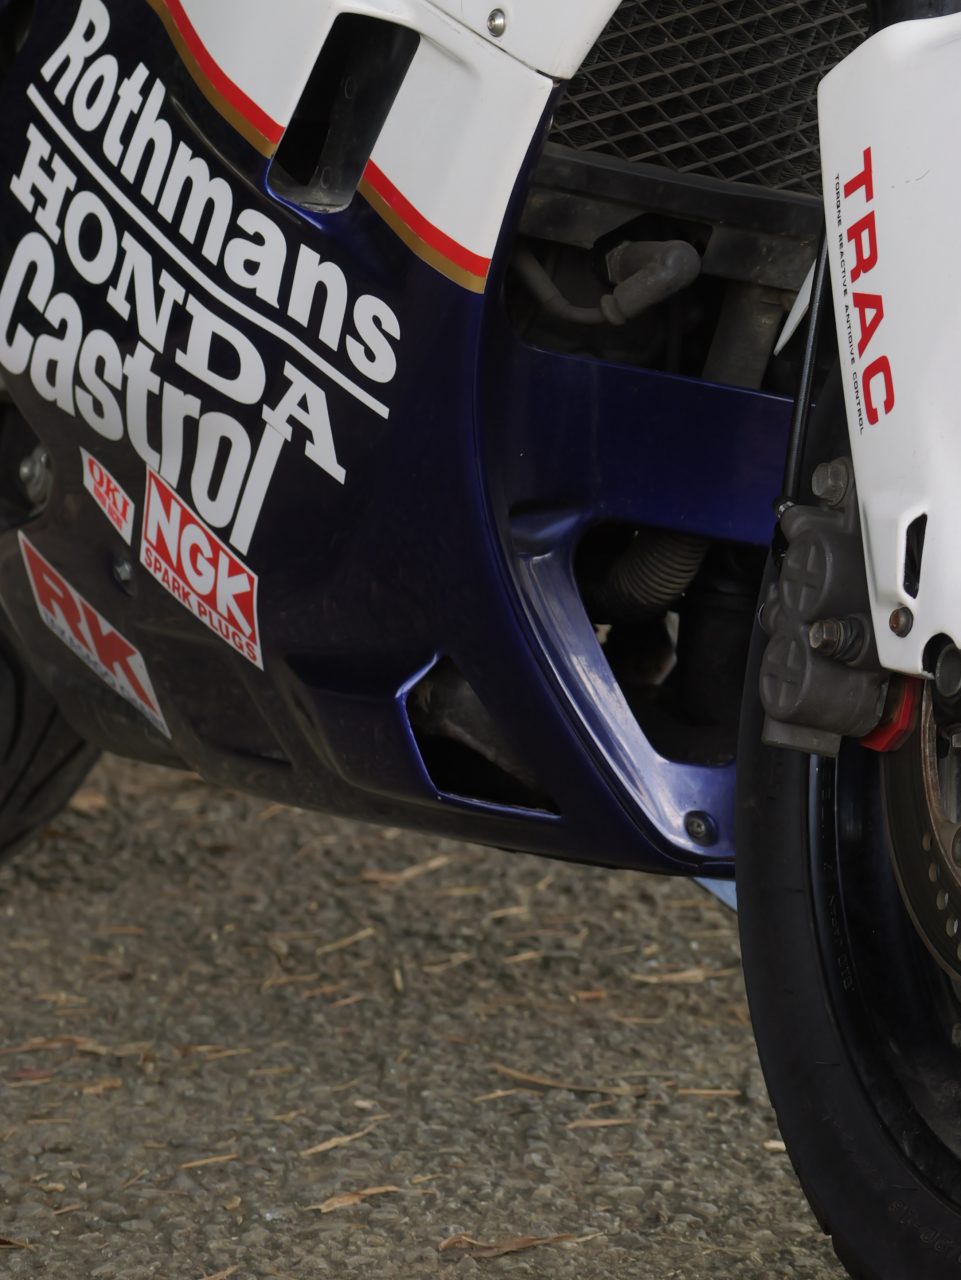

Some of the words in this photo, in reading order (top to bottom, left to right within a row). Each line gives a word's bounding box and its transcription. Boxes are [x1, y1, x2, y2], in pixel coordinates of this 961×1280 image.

[10, 123, 346, 484] HONDA
[838, 233, 848, 297] REACTIVE
[845, 304, 855, 365] ANTIDIVE
[852, 371, 865, 436] CONTROL
[844, 146, 895, 426] TRAC
[0, 231, 287, 556] Castrol
[88, 457, 129, 524] OKI
[147, 498, 253, 638] NGK
[20, 536, 160, 717] RK
[145, 546, 192, 610] SPARK
[197, 600, 257, 663] PLUGS
